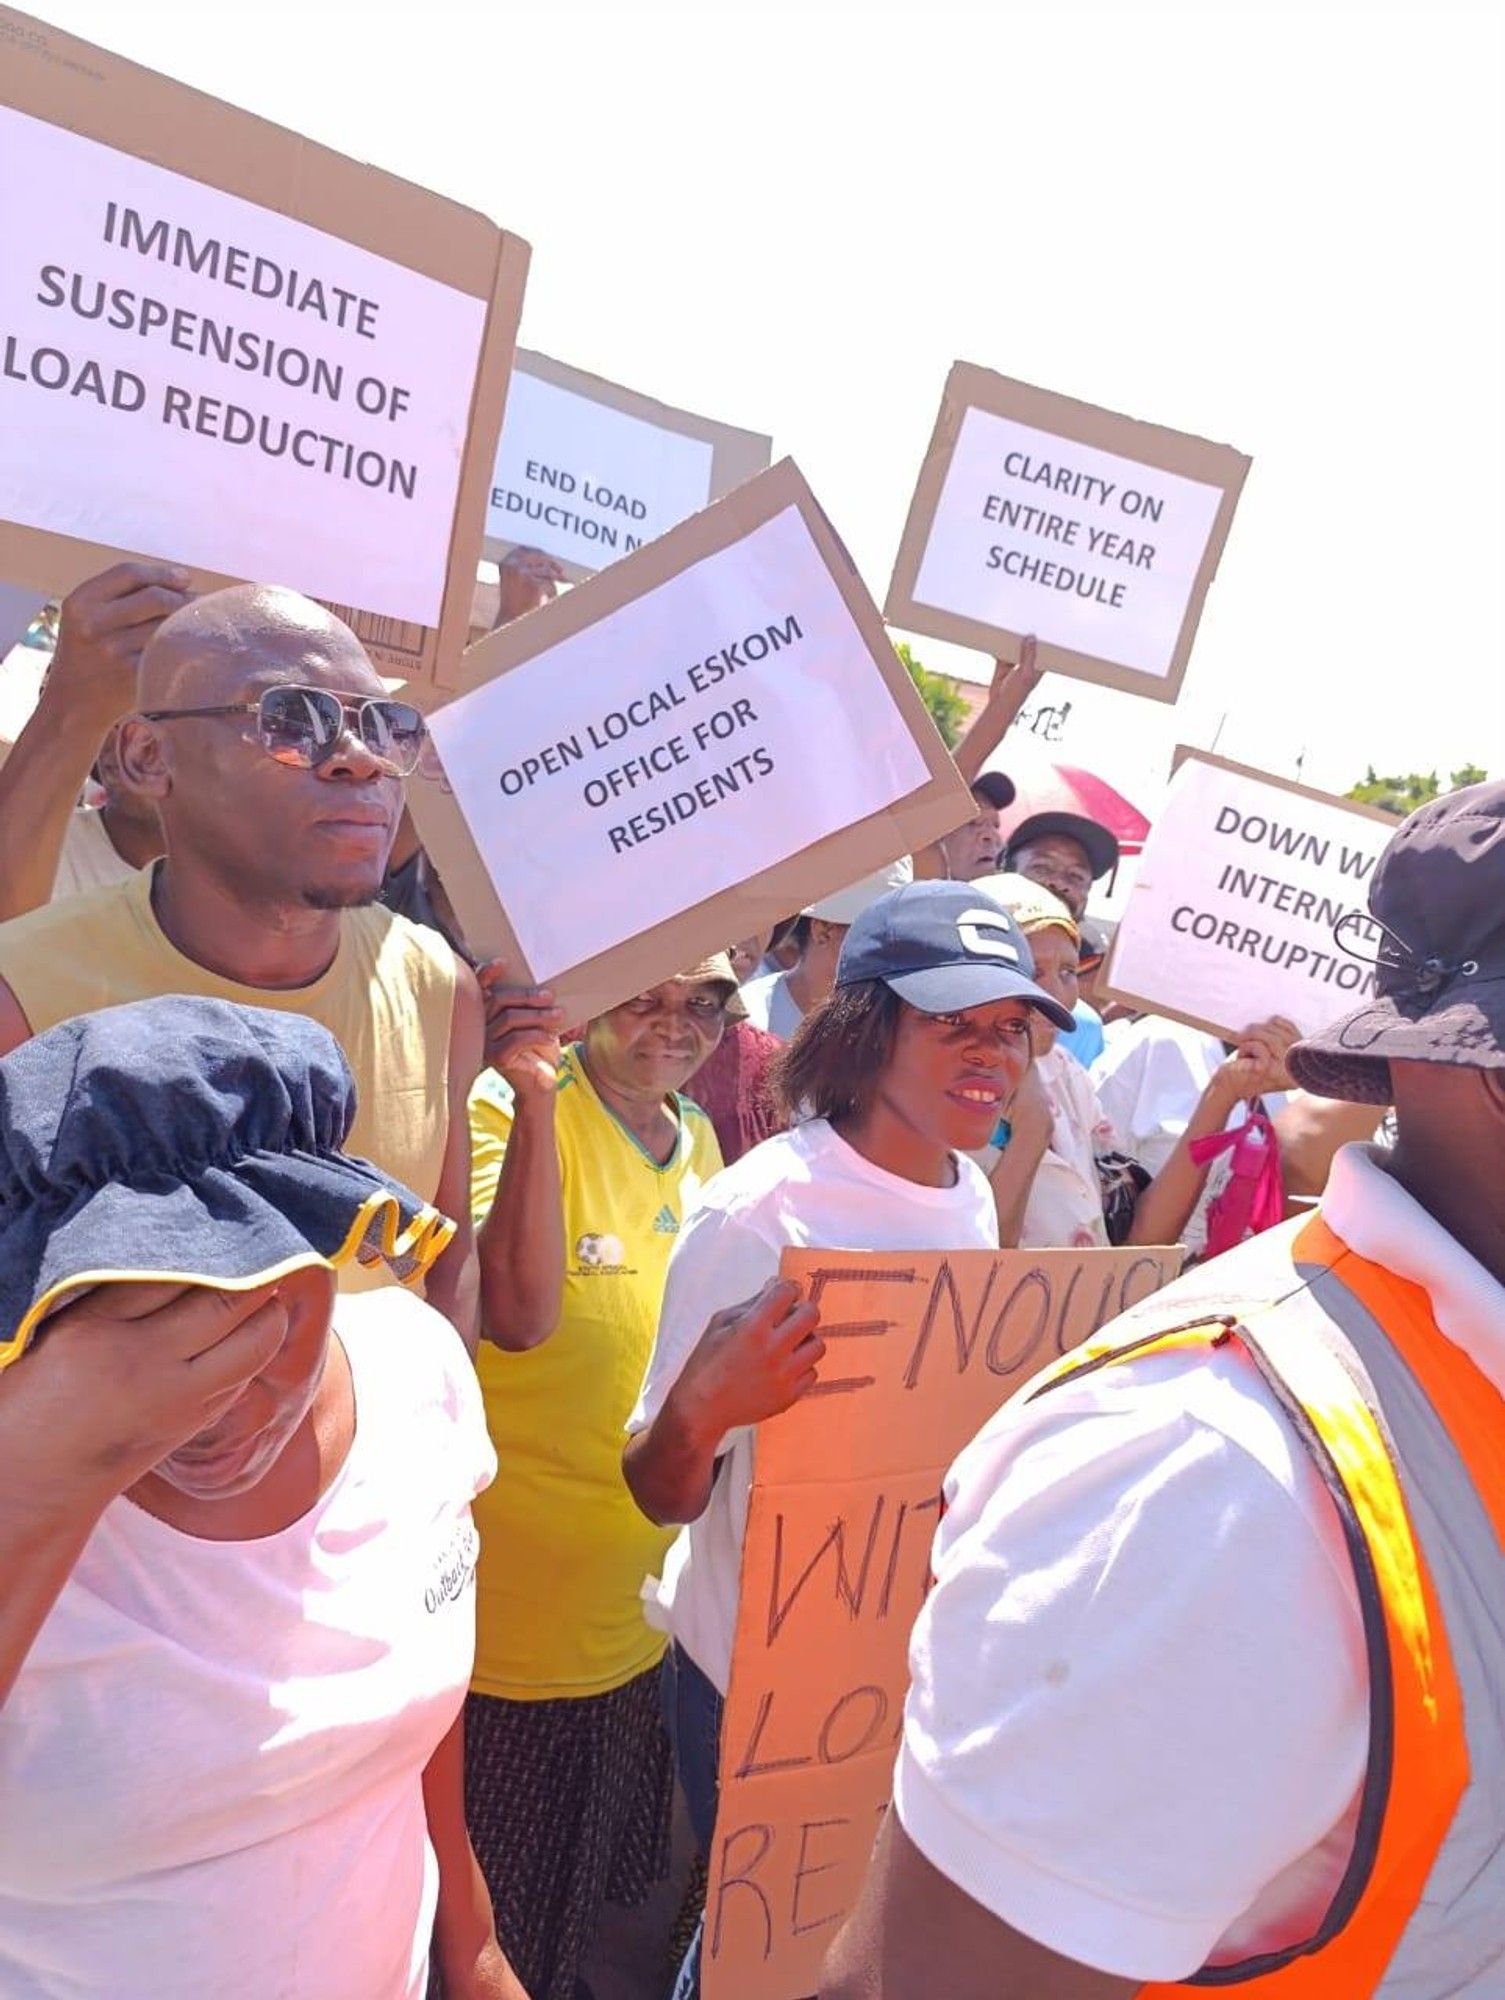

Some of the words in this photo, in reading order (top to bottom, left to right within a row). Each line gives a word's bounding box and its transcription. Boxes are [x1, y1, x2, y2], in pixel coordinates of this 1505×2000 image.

[103, 200, 380, 340] IMMEDIATE
[36, 264, 344, 402] SUSPENSION
[355, 376, 411, 423] OF
[3, 335, 147, 413] LOAD
[162, 385, 419, 501] REDUCTION
[490, 487, 618, 548] EDUCTION
[625, 534, 642, 552] N
[525, 460, 576, 493] END
[583, 481, 647, 520] LOAD
[982, 495, 1081, 546] ENTIRE
[1088, 527, 1156, 570] YEAR
[1003, 452, 1116, 506] CLARITY
[1120, 490, 1164, 523] ON
[986, 545, 1127, 608] SCHEDULE
[499, 734, 584, 796] OPEN
[587, 683, 686, 750] LOCAL
[687, 614, 804, 693] ESKOM
[583, 736, 691, 808] OFFICE
[692, 698, 759, 751] FOR
[607, 747, 775, 854] RESIDENTS
[1214, 805, 1331, 866] DOWN
[1338, 846, 1377, 880] W
[1170, 906, 1379, 999] CORRUPTION
[1217, 864, 1379, 943] INTERNAL
[766, 1493, 945, 1648] WI
[734, 1684, 903, 1782] LO
[711, 1803, 888, 1960] RE
